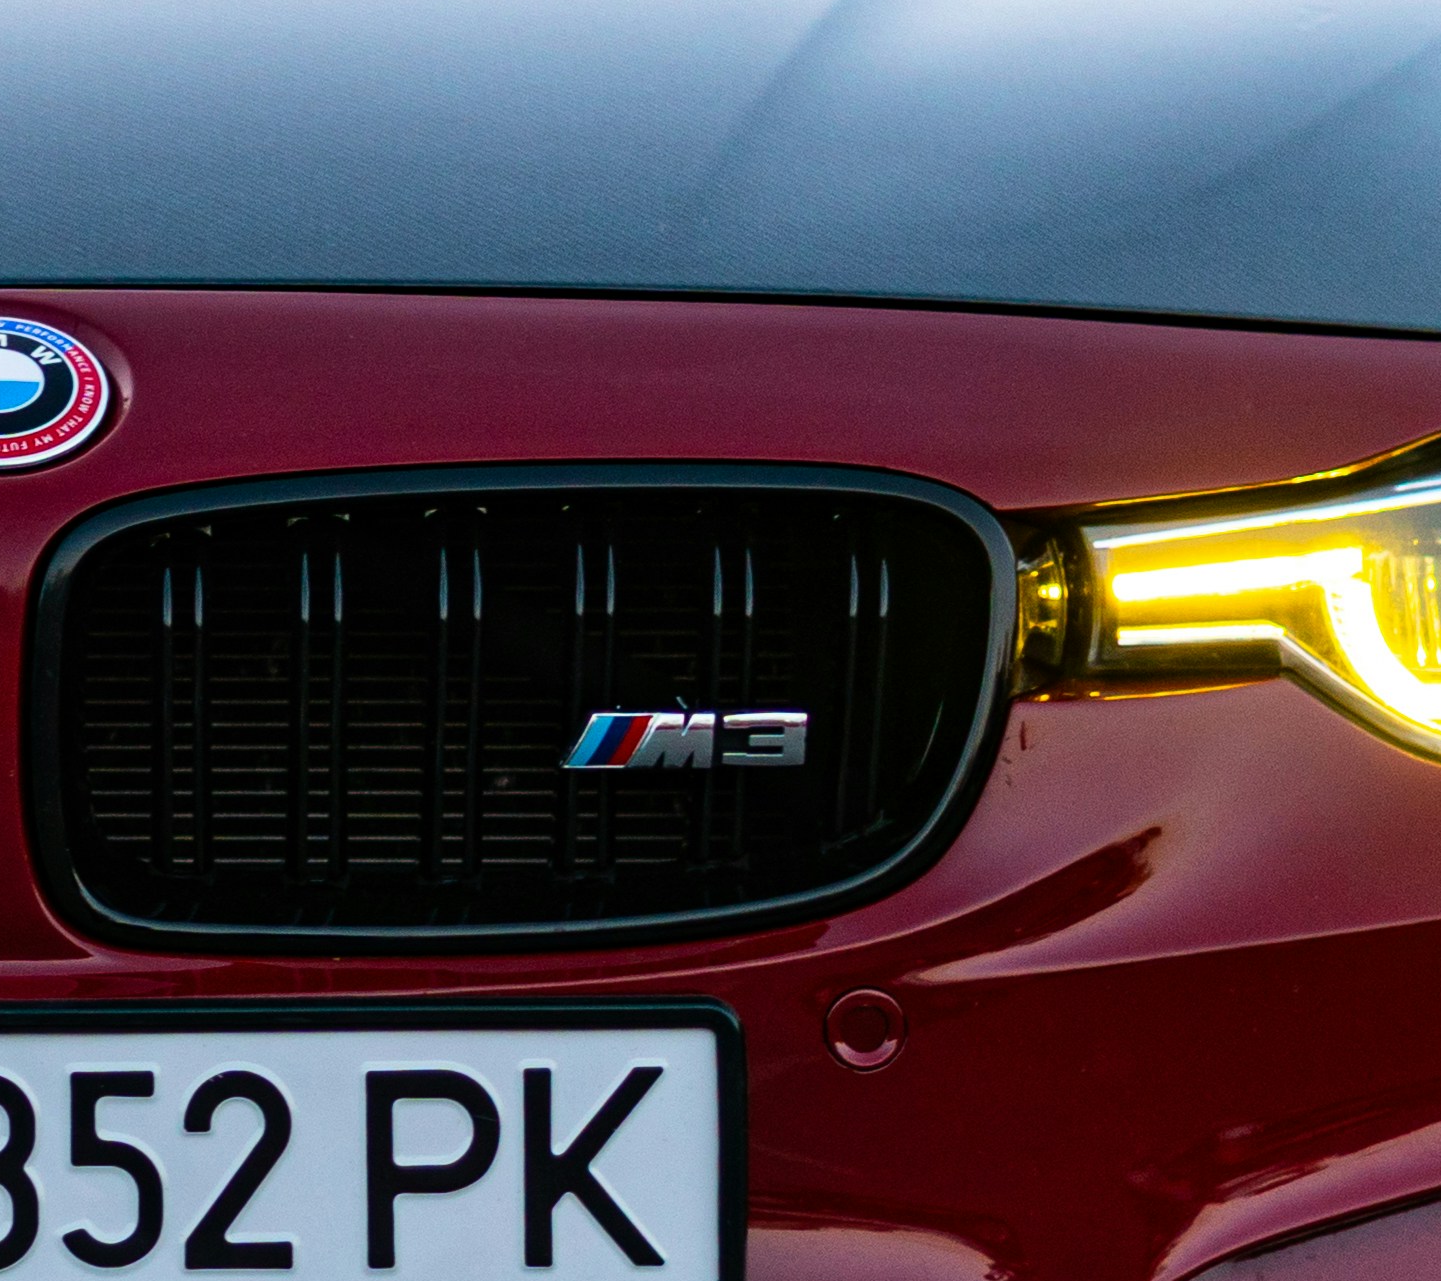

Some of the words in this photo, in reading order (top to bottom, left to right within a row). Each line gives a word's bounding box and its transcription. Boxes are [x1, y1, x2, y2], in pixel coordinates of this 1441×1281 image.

[15, 324, 92, 373] PERFORMANCE
[79, 383, 95, 414] KNOW
[34, 435, 54, 447] MY
[56, 415, 84, 437] THAT
[628, 712, 808, 768] M3
[366, 1065, 667, 1270] PK
